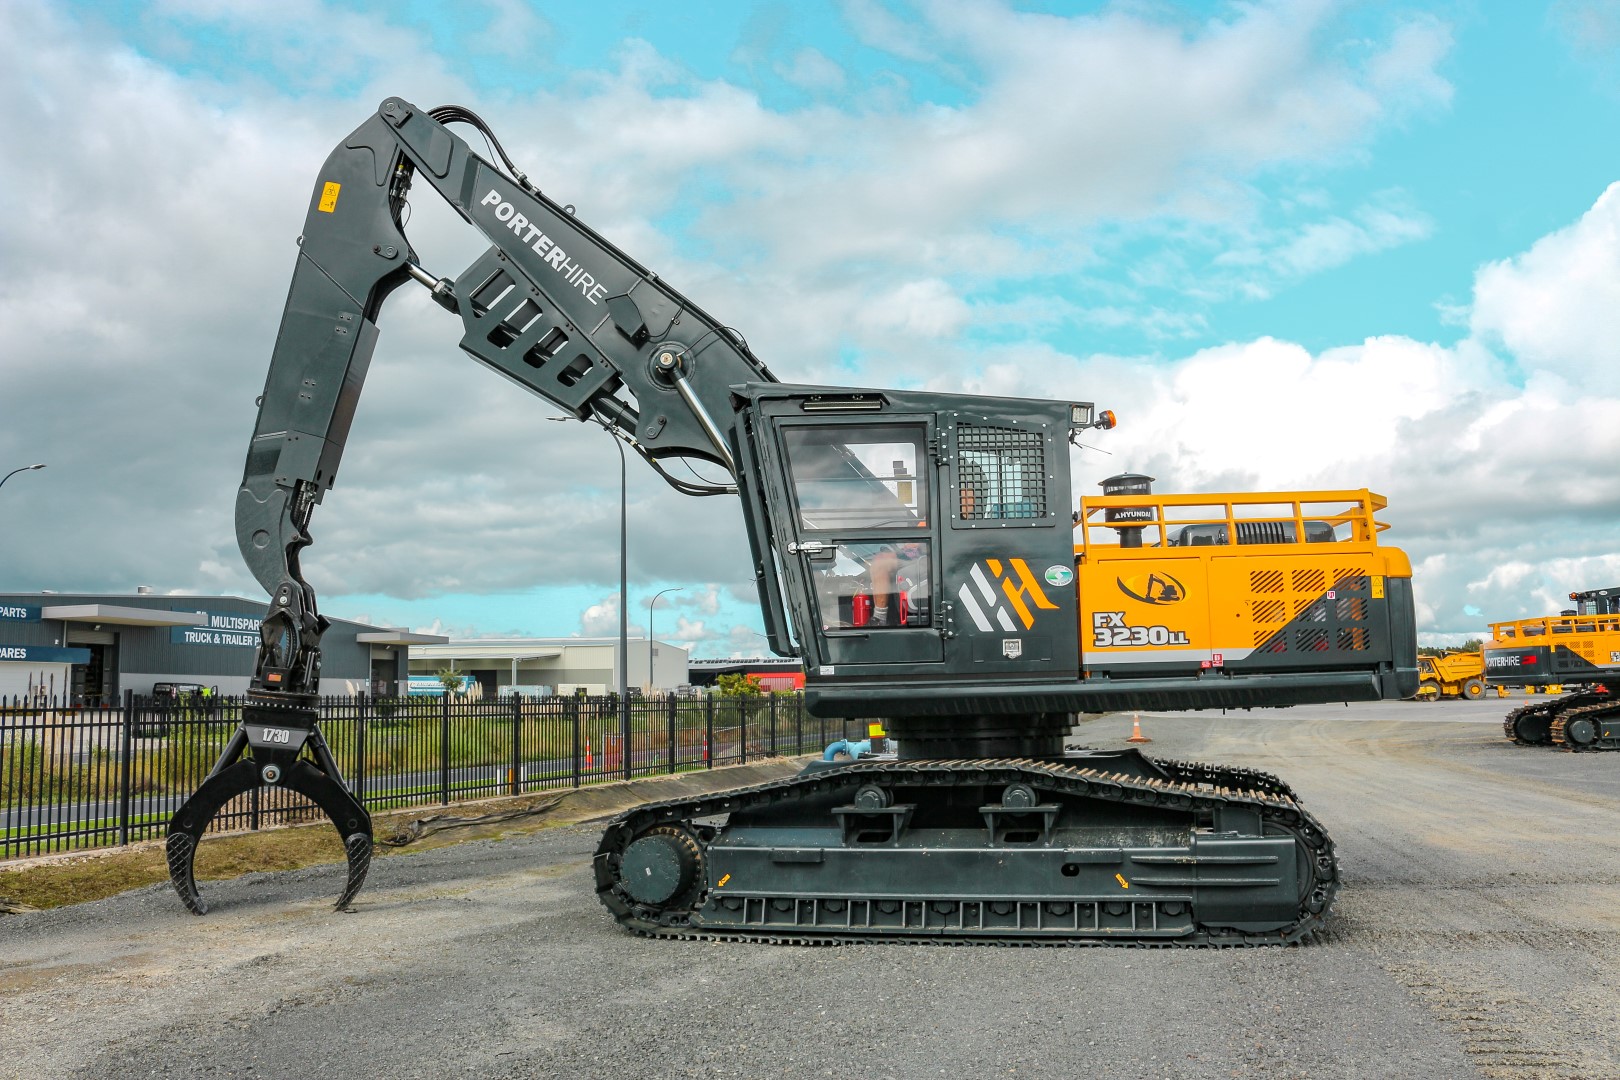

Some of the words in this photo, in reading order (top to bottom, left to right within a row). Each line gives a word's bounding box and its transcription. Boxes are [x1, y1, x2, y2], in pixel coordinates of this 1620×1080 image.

[480, 189, 608, 306] PORTERHIRE
[1093, 611, 1126, 628] FX
[184, 631, 212, 644] TRUCK
[213, 633, 221, 644] &
[221, 634, 253, 646] TRAILER
[0, 647, 27, 659] ARES
[262, 727, 290, 744] 1730
